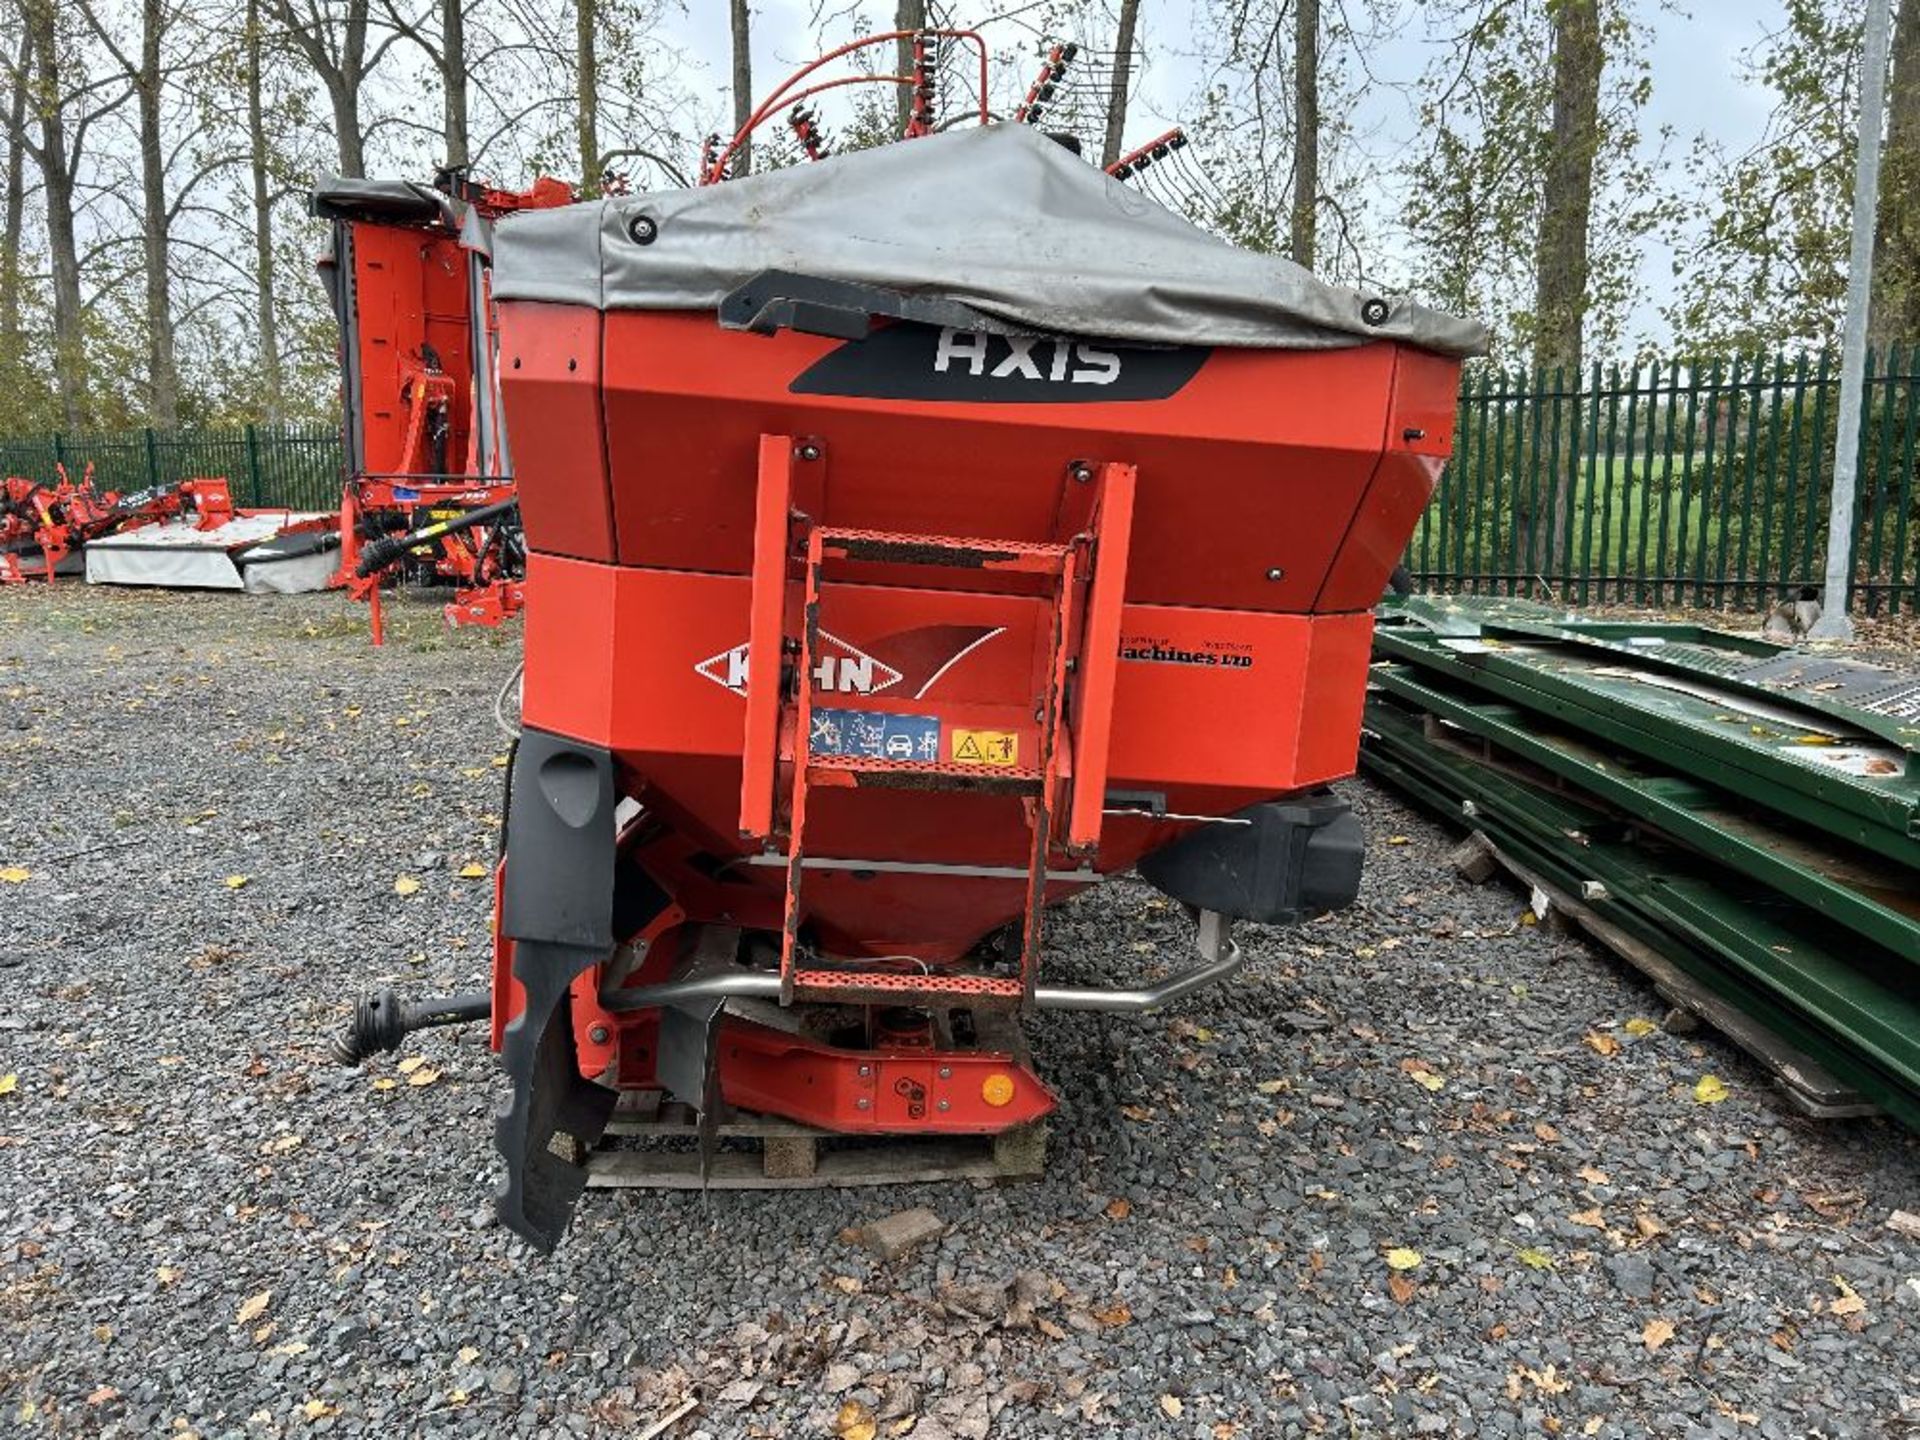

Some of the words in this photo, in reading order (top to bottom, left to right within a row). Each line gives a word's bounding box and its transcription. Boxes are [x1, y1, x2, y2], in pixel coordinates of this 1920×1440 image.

[934, 328, 1121, 384] AXIS
[1118, 644, 1218, 665] achines
[1220, 654, 1253, 667] LTD
